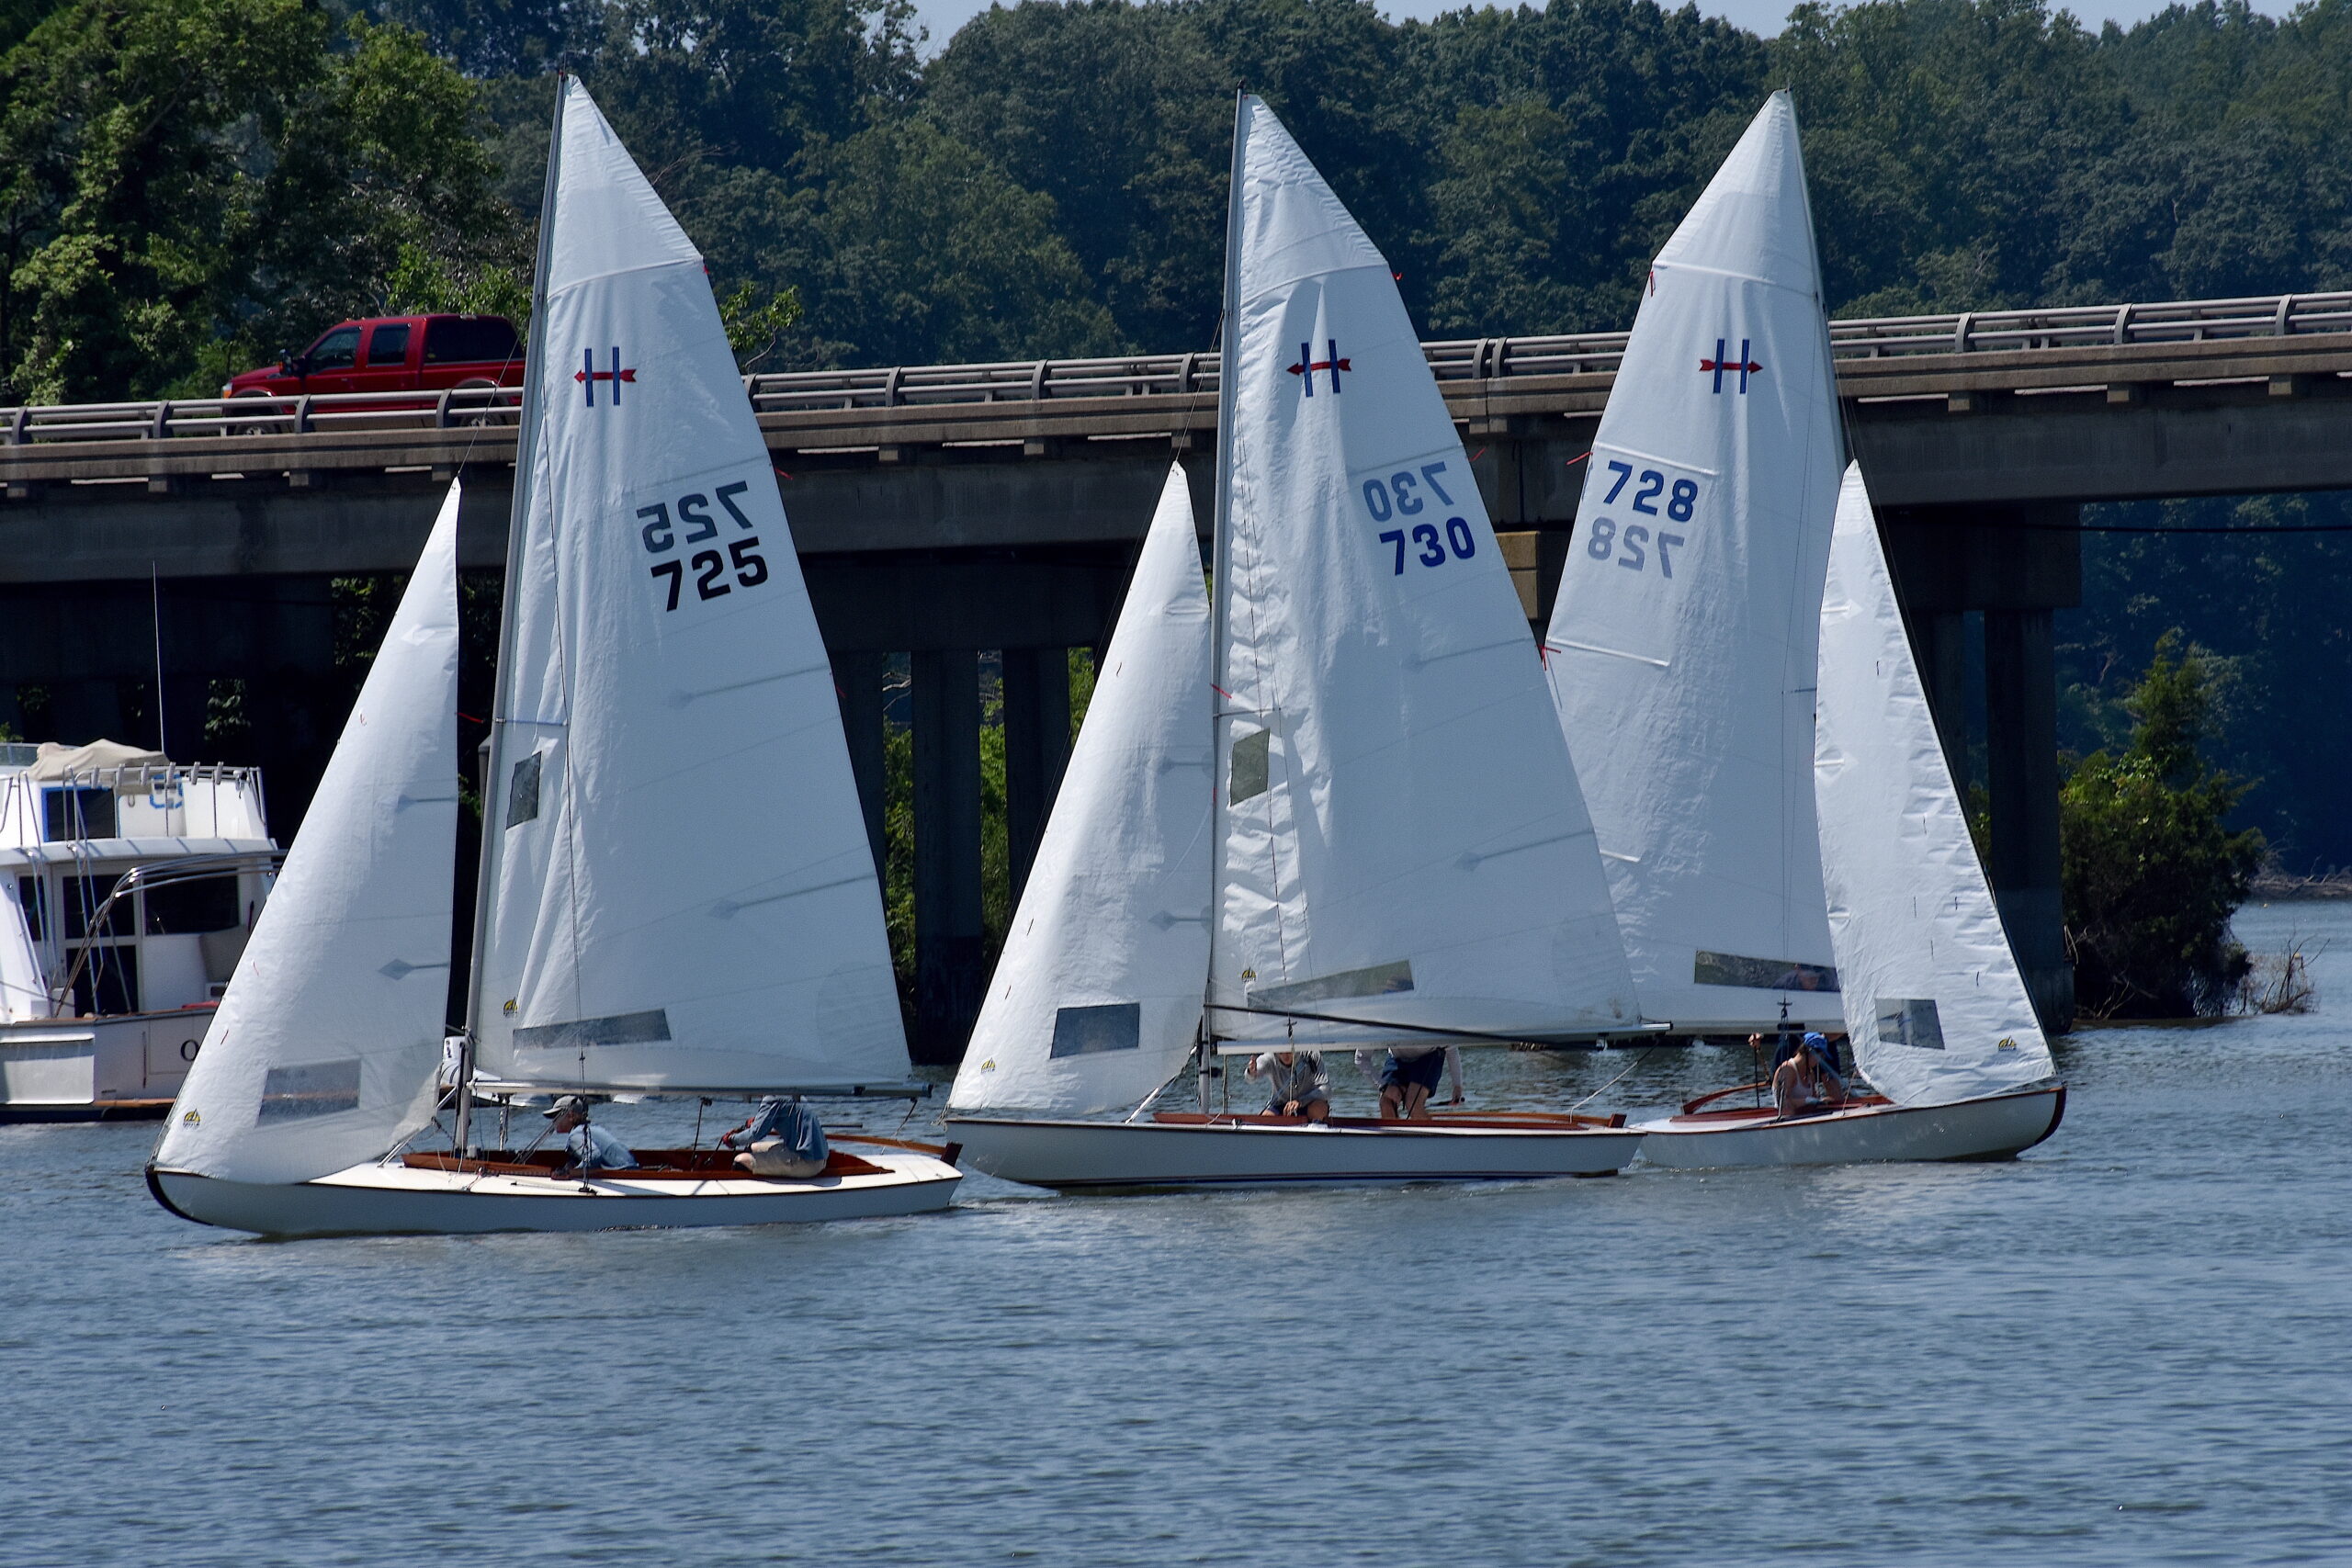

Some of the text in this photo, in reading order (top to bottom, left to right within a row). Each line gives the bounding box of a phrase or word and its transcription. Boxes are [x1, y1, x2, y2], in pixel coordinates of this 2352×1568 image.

[1603, 460, 1698, 523] 728
[650, 536, 768, 612] 725
[1379, 516, 1476, 576] 730
